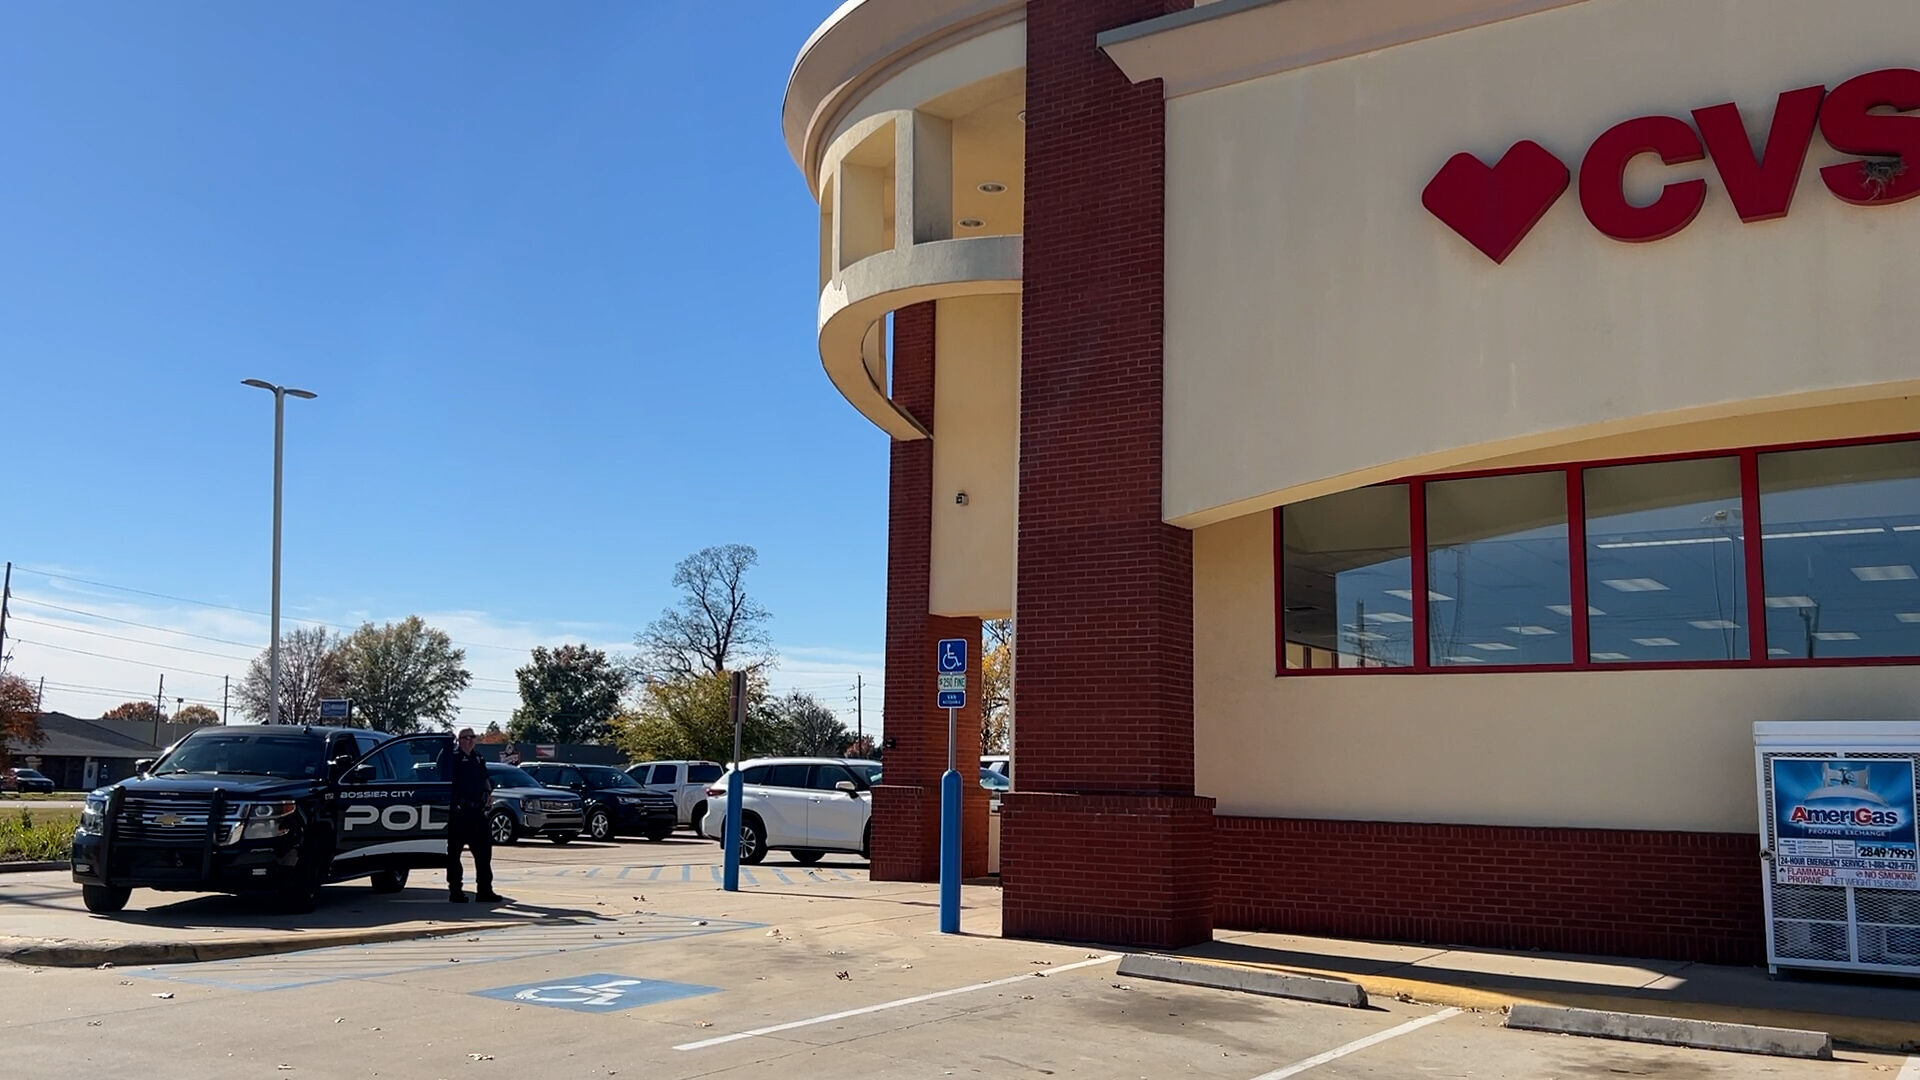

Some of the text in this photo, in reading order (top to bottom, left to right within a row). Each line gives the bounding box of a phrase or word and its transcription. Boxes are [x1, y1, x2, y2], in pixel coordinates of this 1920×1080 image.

[1579, 68, 1920, 243] CVS
[954, 677, 965, 688] FINE
[340, 791, 388, 799] BOSSIER
[390, 790, 415, 798] CITY
[344, 804, 449, 831] POL
[1790, 805, 1898, 827] AmeriGas
[1808, 828, 1886, 837] PROPANE EXCHANGE
[1780, 856, 1805, 866] 24-HOUR
[1806, 857, 1840, 867] EMERGENCY
[1787, 867, 1836, 878] FLAMMABLE
[1864, 870, 1917, 881] NO SMOKING
[1787, 876, 1823, 884] PROPANE
[1831, 877, 1844, 885] NET
[1845, 878, 1871, 887] WEIGHT
